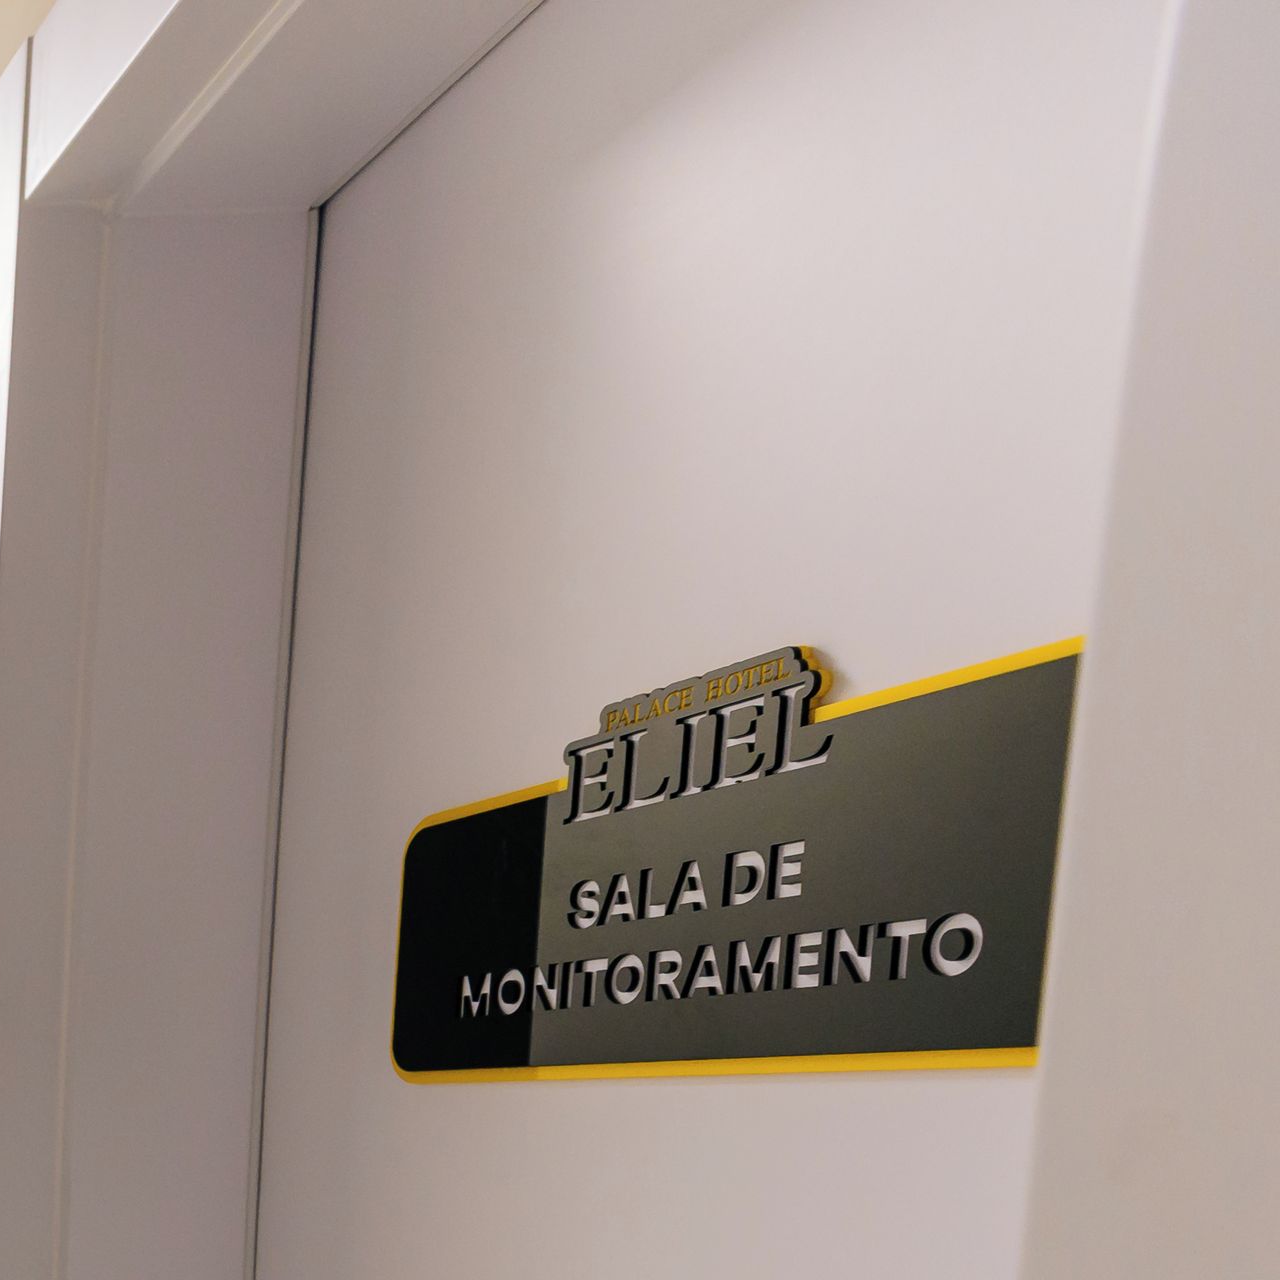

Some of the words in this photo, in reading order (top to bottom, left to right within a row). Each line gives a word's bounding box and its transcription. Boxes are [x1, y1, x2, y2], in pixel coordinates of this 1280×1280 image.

[605, 686, 694, 733] PALACE
[706, 657, 791, 701] HOTEL
[563, 681, 833, 825] ELIEL
[567, 860, 707, 929] SALA
[722, 840, 805, 907] DE
[459, 912, 983, 1018] MONITORAMENTO
